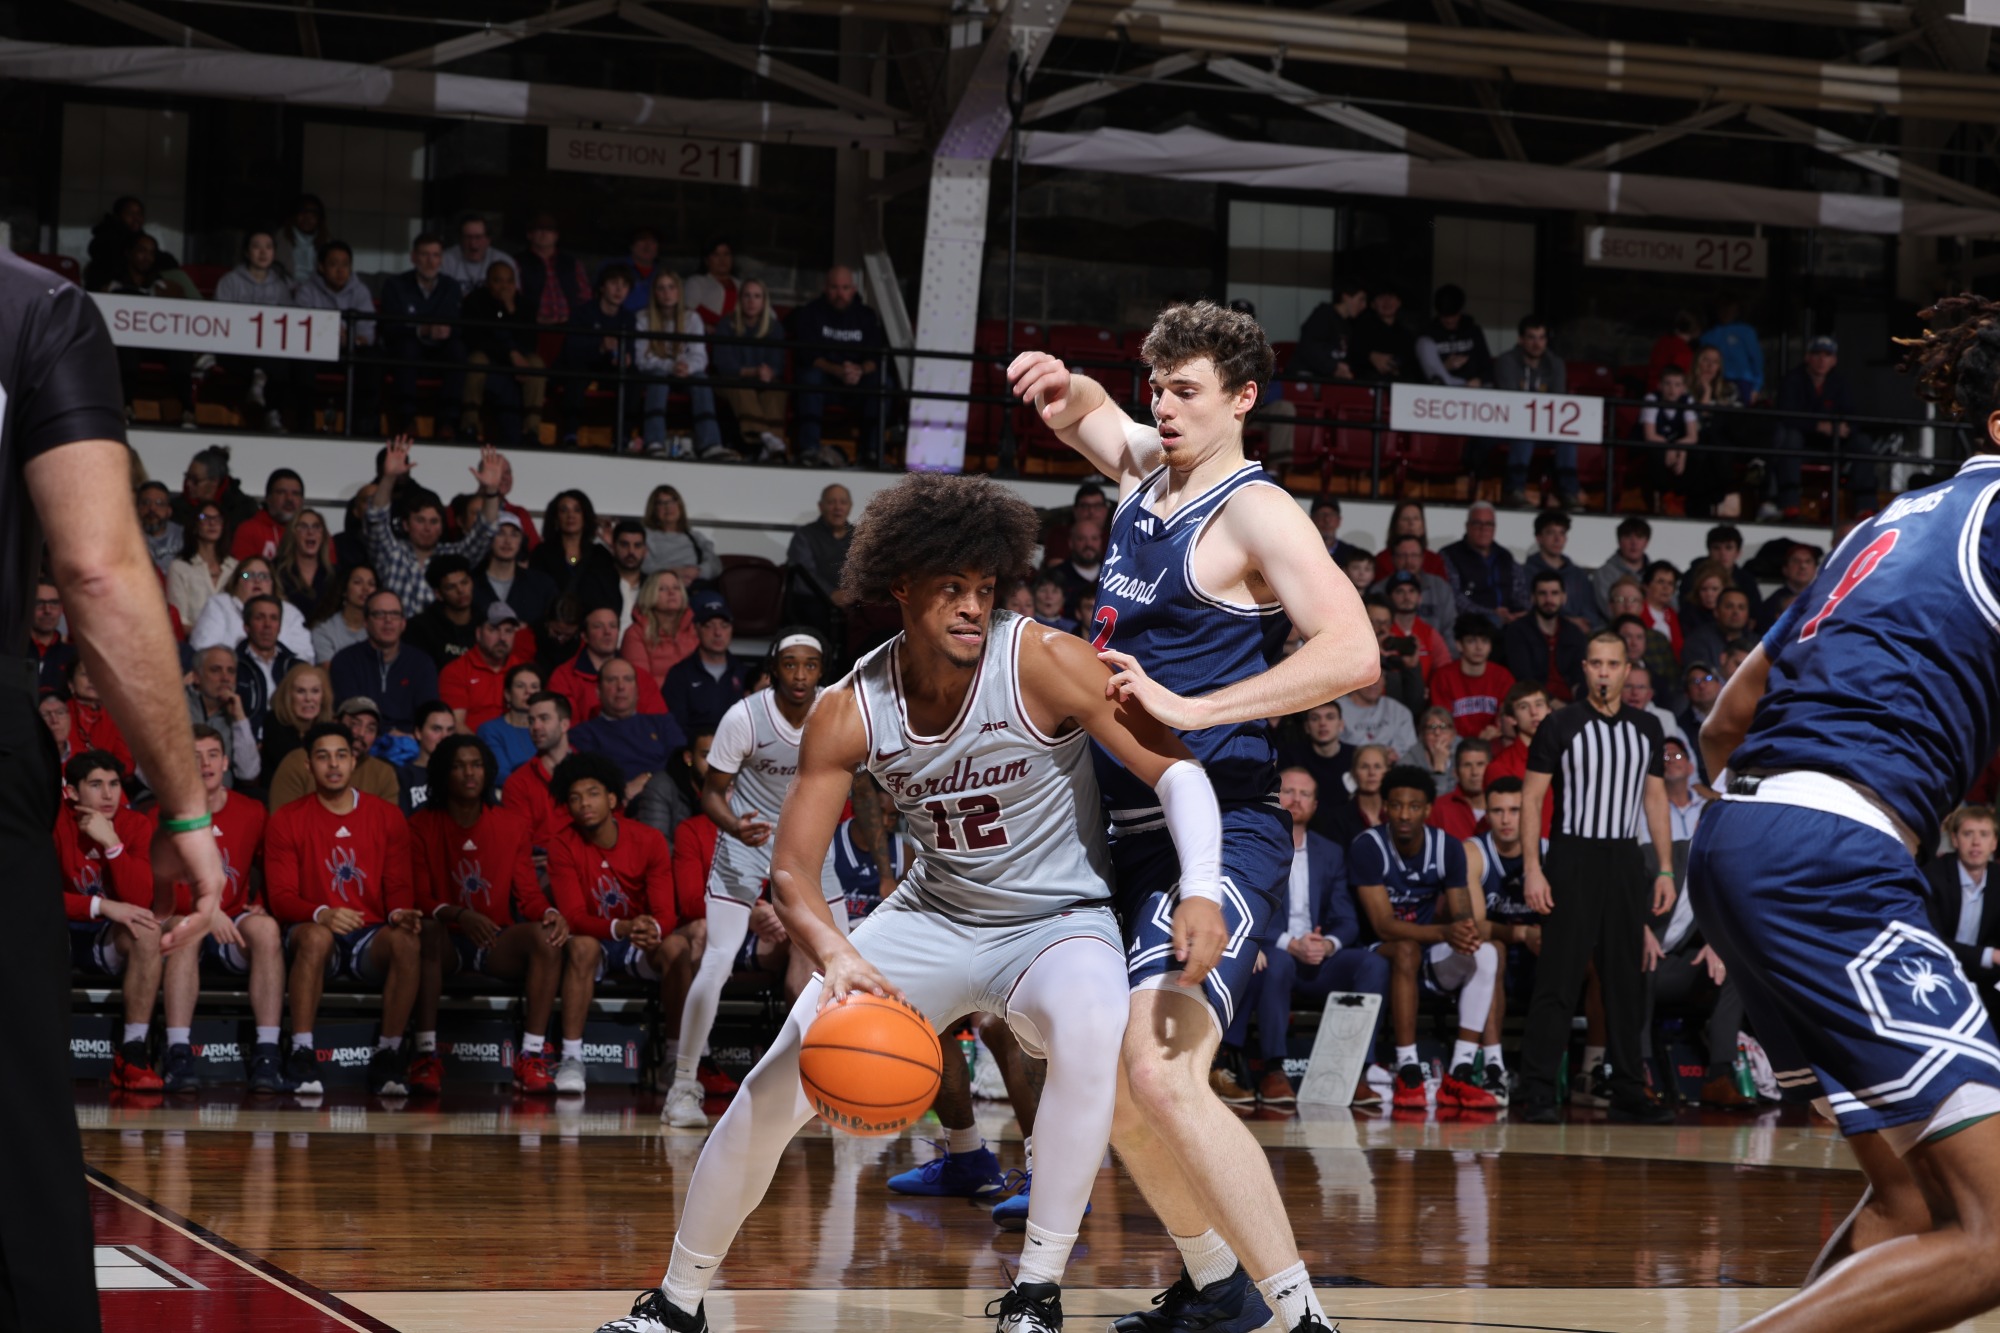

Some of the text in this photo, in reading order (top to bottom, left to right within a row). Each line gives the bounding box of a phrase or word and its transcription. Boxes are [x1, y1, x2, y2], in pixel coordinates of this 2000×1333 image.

[568, 139, 742, 181] SECTION 211
[1601, 237, 1754, 274] SECTION 212
[114, 309, 313, 353] SECTION 111
[1413, 397, 1582, 436] SECTION 112
[979, 720, 1009, 734] A10
[885, 756, 1033, 798] Fordham
[922, 794, 1012, 853] 12
[814, 1094, 909, 1132] Wilson
